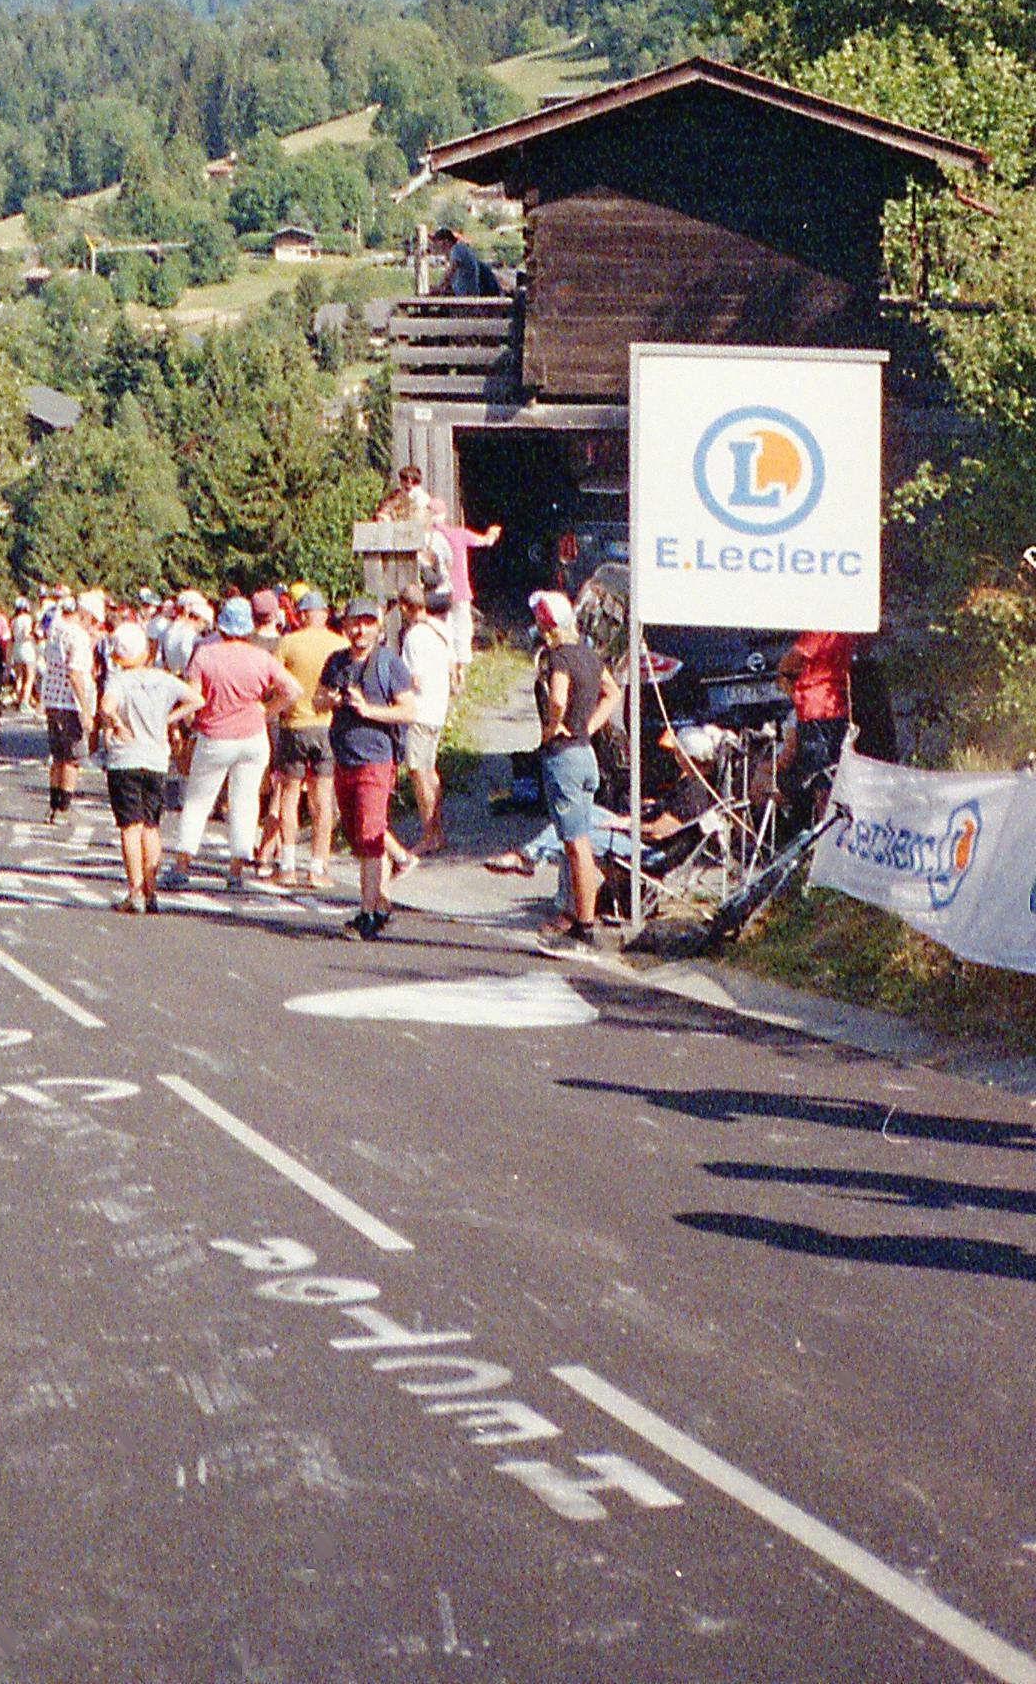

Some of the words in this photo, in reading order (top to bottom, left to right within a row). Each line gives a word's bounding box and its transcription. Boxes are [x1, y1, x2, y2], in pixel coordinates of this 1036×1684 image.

[729, 440, 783, 507] L
[655, 537, 863, 579] E.Leclerc
[209, 1236, 685, 1521] HECTOR
